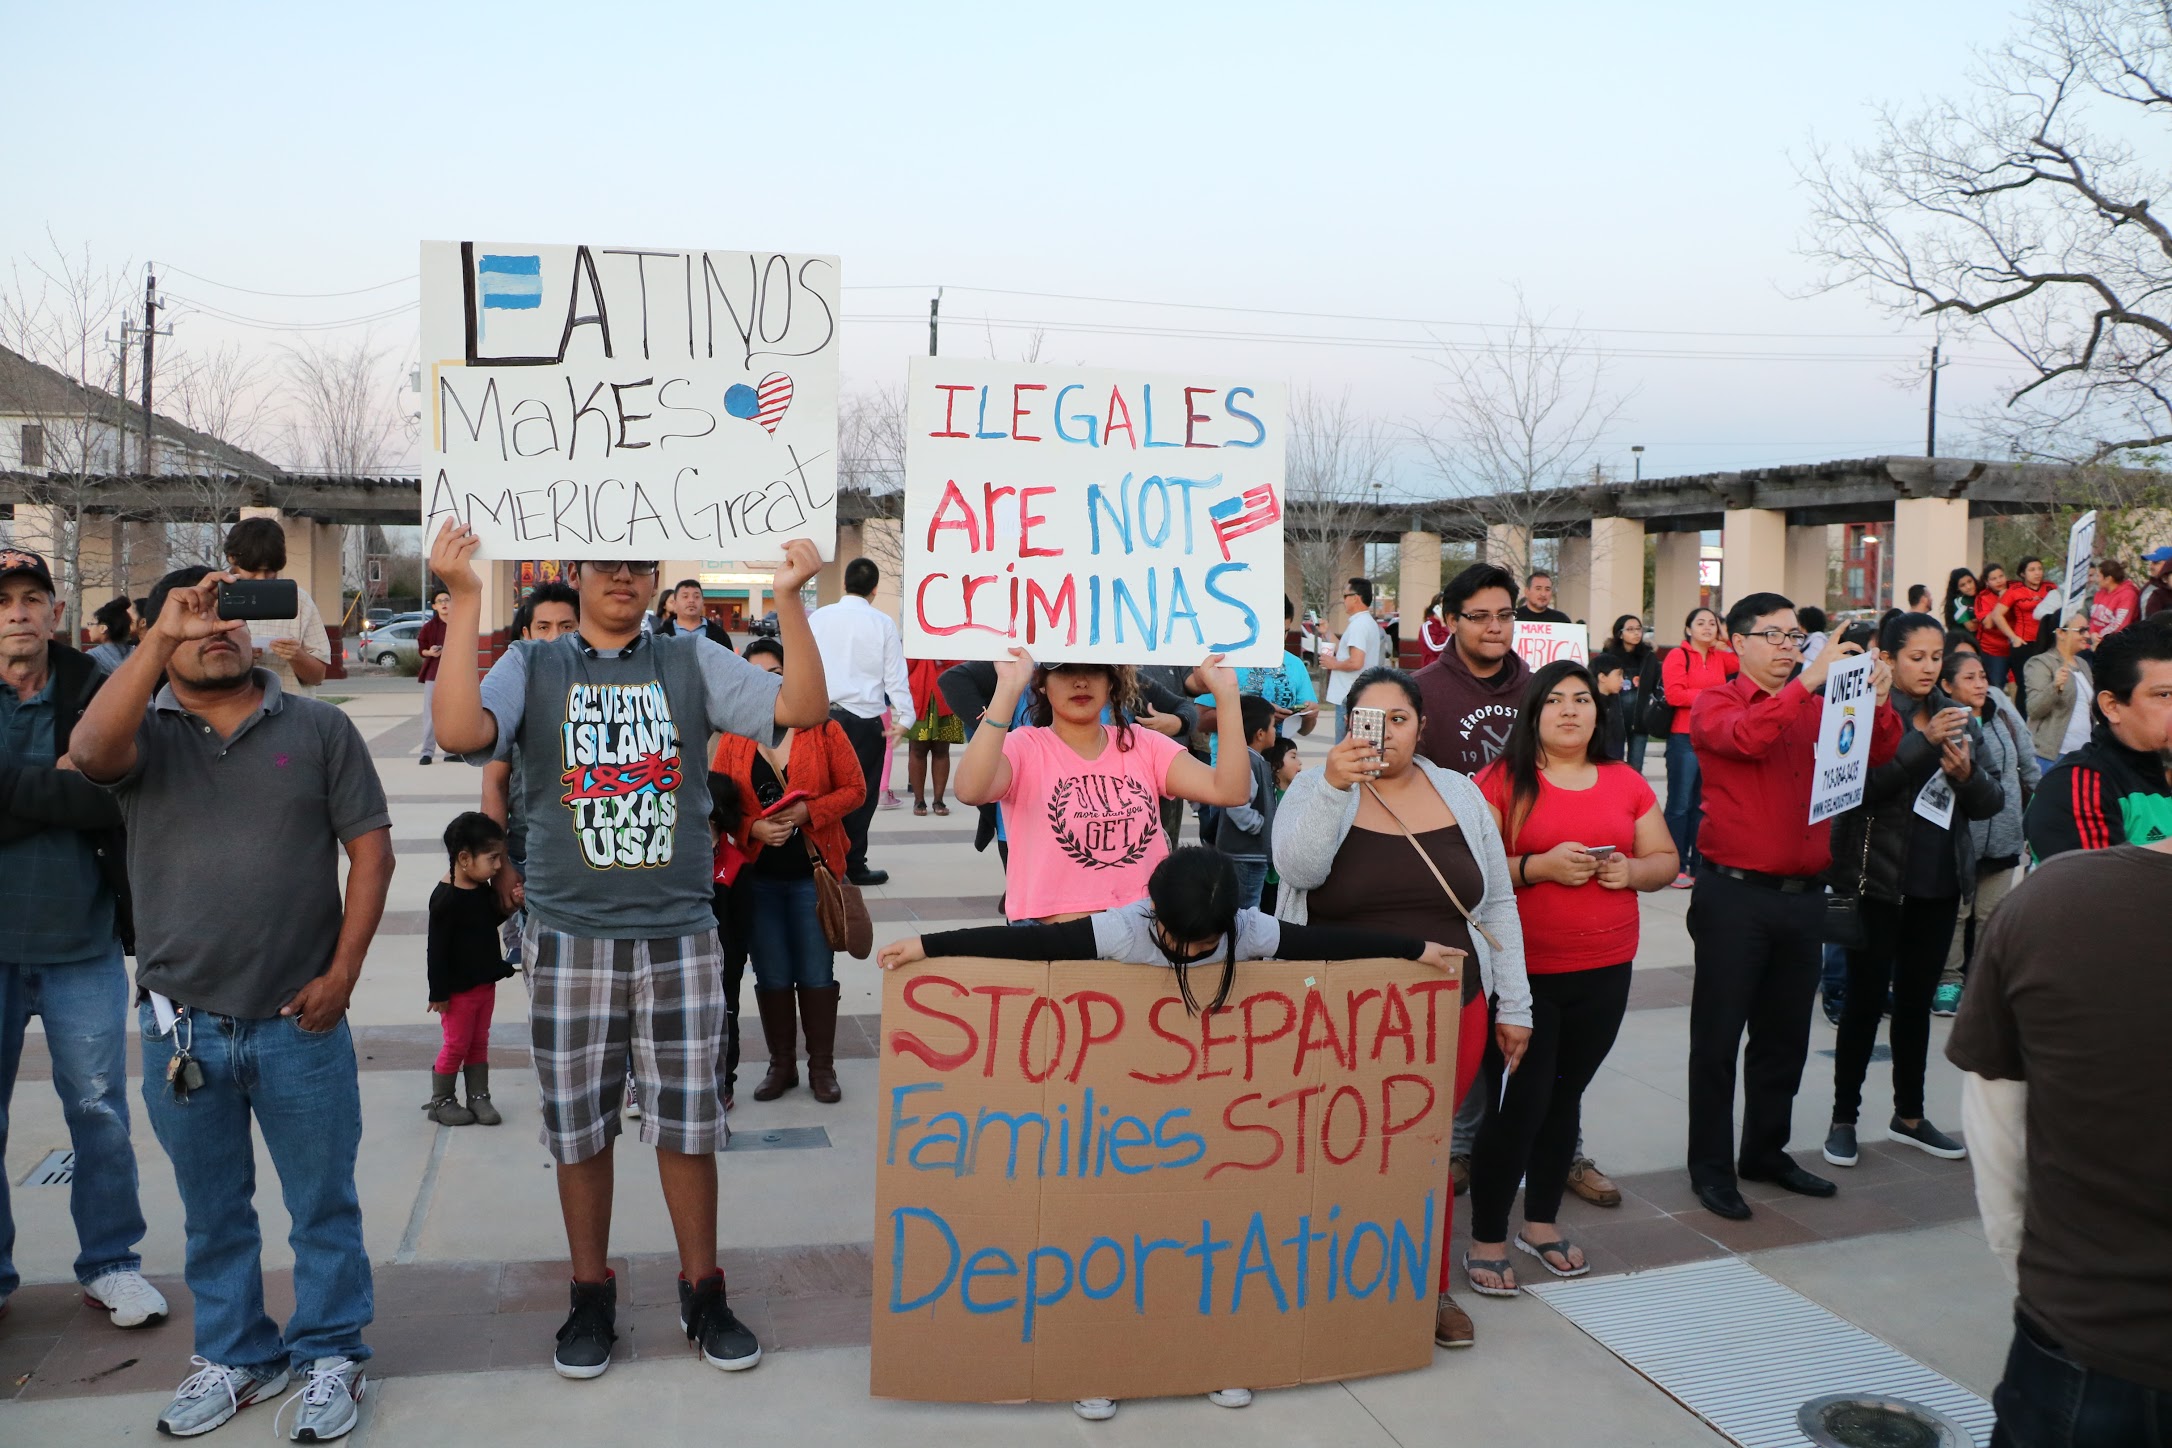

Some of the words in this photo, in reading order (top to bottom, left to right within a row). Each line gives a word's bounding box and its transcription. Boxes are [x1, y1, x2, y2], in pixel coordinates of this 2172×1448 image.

[461, 241, 834, 370] LATINOS
[440, 376, 716, 461] MaKES
[928, 383, 1267, 451] ILEGALES
[424, 468, 670, 545] AMERICA
[674, 445, 835, 548] Great
[1087, 472, 1223, 555] NOT
[1521, 623, 1552, 634] MAKE
[568, 681, 671, 724] GALVESTON
[1831, 667, 1865, 705] UNETE
[563, 719, 679, 769] ISLAND
[560, 752, 682, 804] 1836
[569, 791, 677, 829] TEXAS
[1074, 811, 1100, 819] more
[1126, 806, 1143, 817] you
[1086, 817, 1135, 851] GET
[581, 828, 673, 866] USA
[889, 975, 1126, 1084] STOP
[886, 1080, 1207, 1180] Families
[1203, 1074, 1436, 1180] STOP
